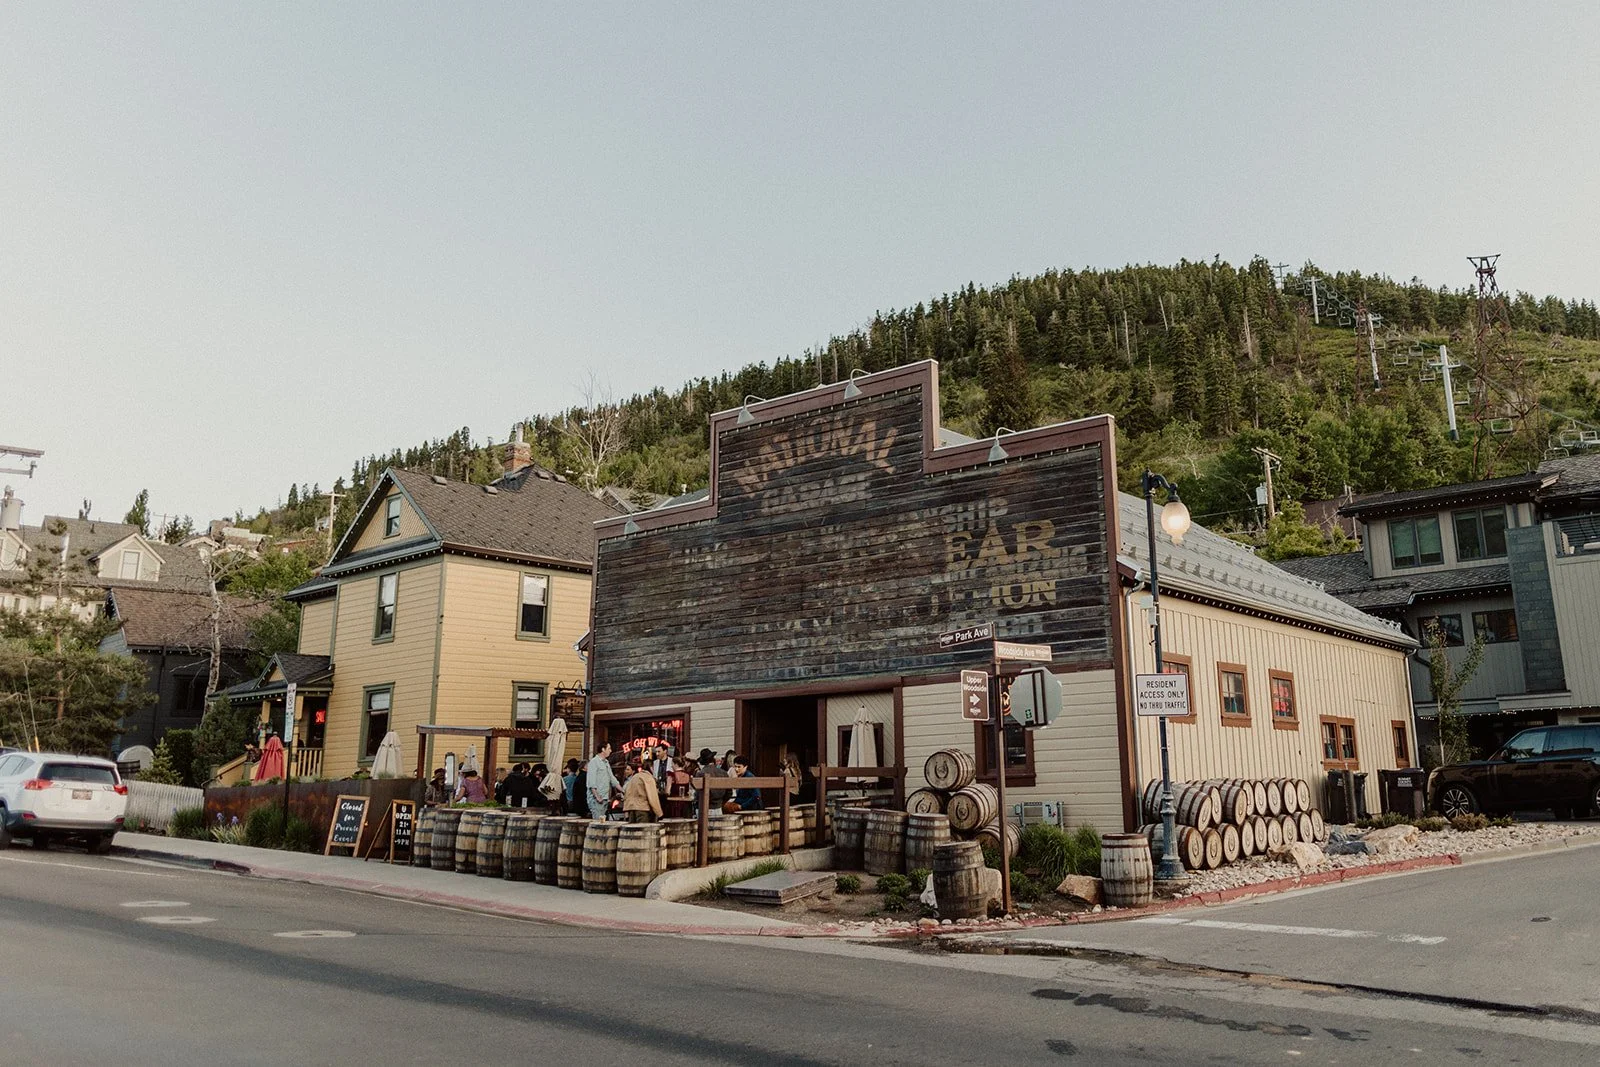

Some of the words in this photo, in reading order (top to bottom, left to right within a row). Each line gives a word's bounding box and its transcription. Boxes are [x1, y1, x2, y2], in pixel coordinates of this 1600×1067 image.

[955, 629, 973, 642] Park
[973, 627, 989, 638] Ave
[998, 645, 1023, 657] Woodside
[1024, 648, 1035, 657] Ave
[966, 676, 983, 685] Upper
[1146, 680, 1177, 688] RESIDENT
[963, 683, 987, 692] Woodside
[1167, 690, 1185, 698] ONLY
[1140, 701, 1148, 709] NO
[1149, 701, 1163, 709] THRU
[1165, 701, 1186, 709] TRAFFIC
[341, 802, 363, 811] Closed
[344, 814, 355, 822] for
